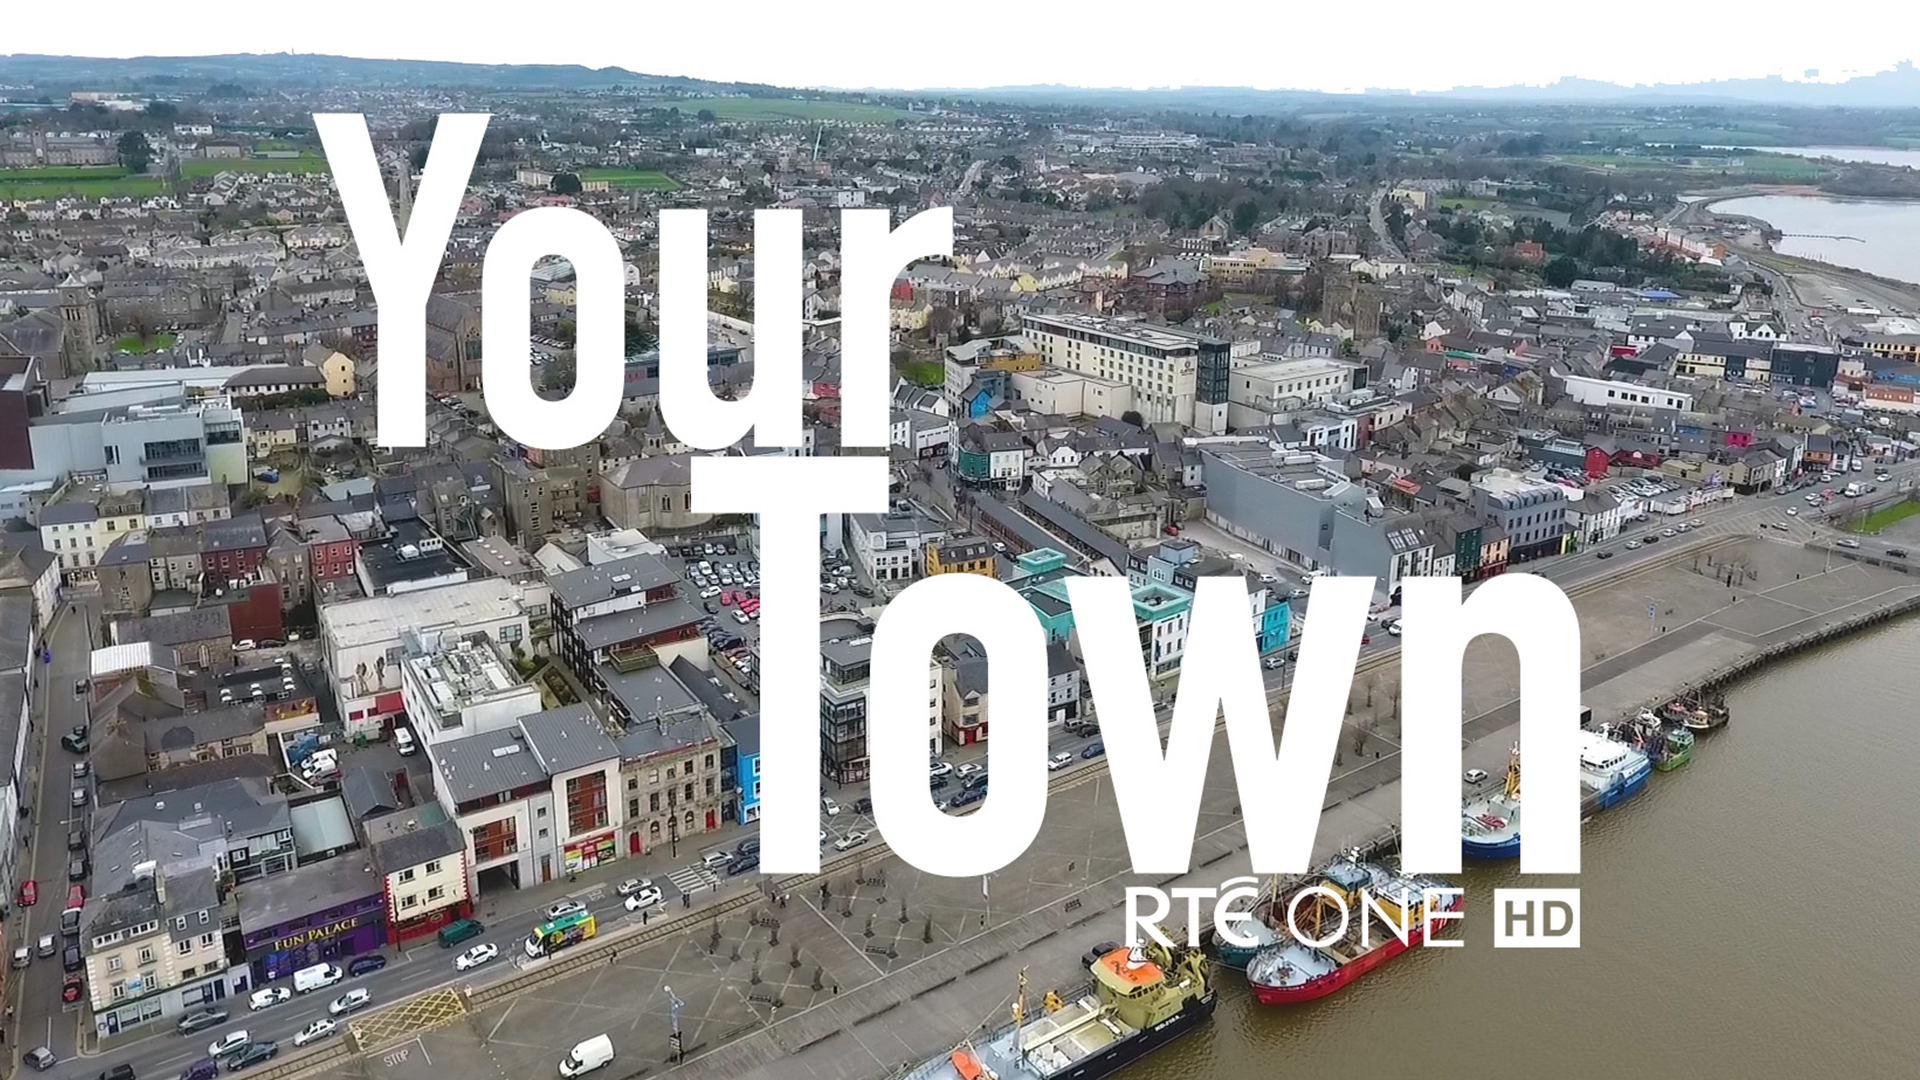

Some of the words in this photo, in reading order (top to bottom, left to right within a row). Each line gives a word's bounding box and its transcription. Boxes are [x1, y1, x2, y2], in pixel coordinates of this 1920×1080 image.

[274, 934, 304, 951] FUN
[308, 917, 359, 941] PALACE
[383, 1049, 409, 1067] STOP
